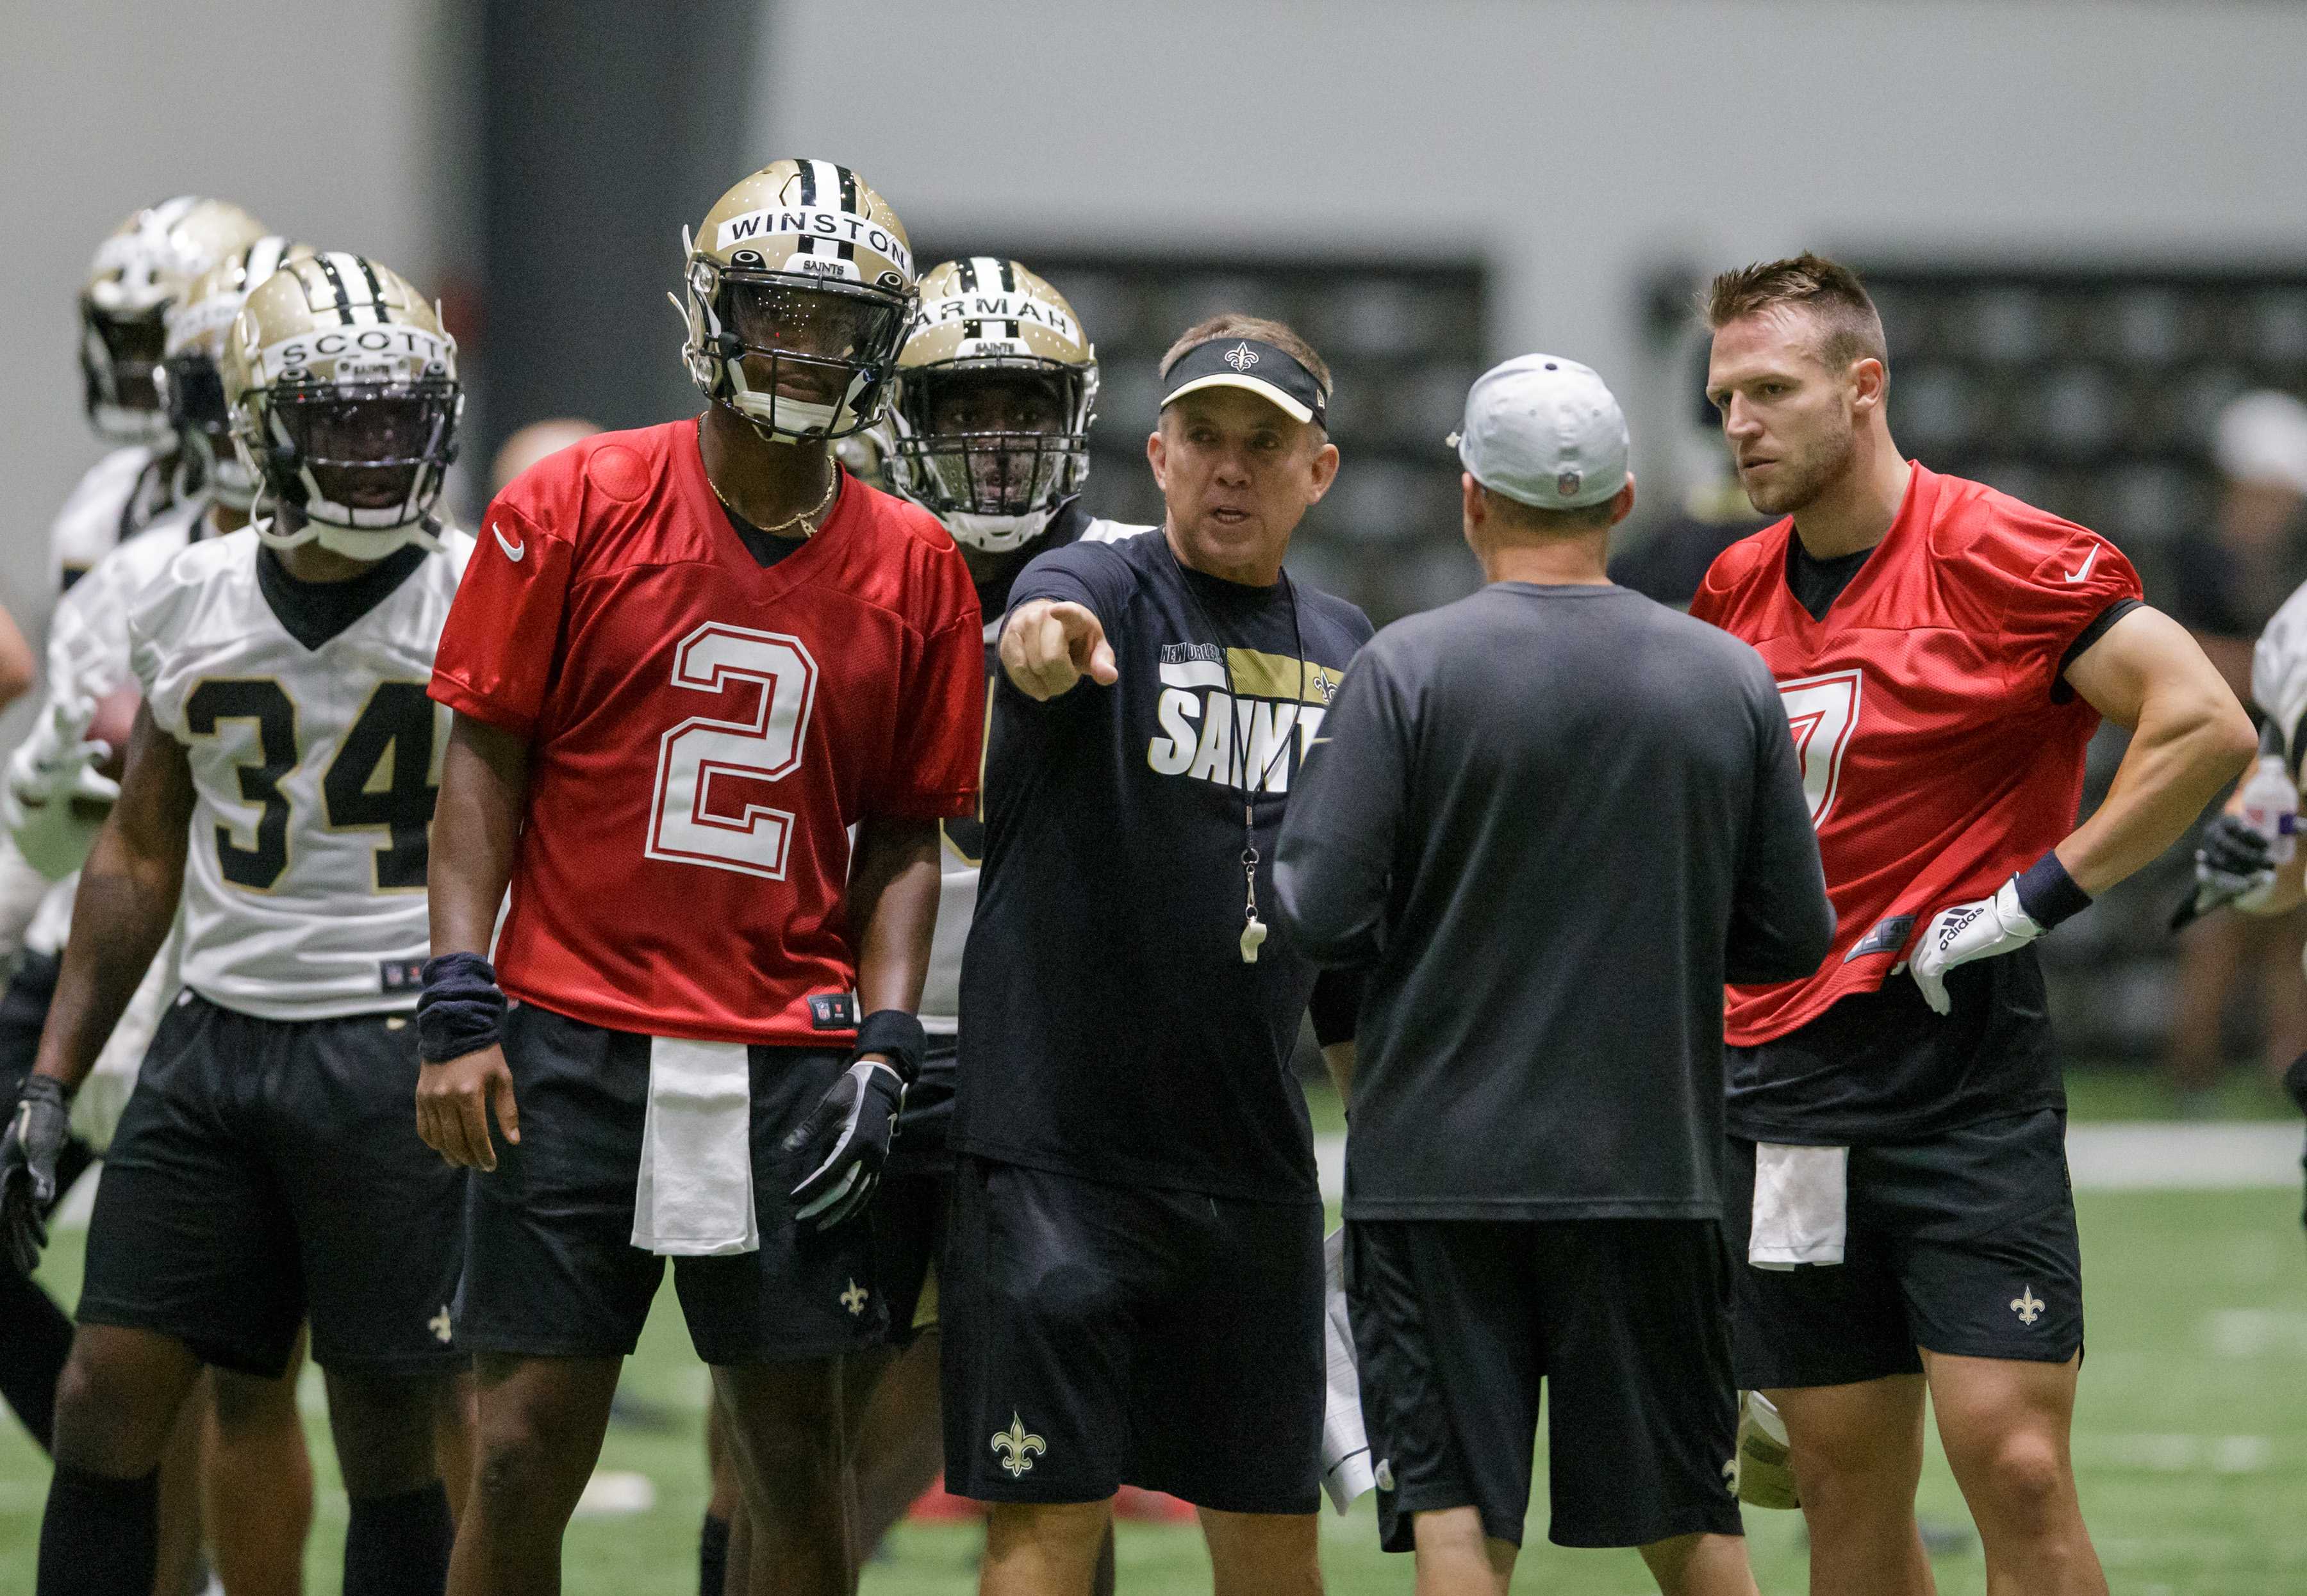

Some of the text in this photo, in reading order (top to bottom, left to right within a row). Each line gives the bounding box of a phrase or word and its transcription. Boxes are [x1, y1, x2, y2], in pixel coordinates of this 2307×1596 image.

[732, 211, 905, 270] WINSTON
[804, 260, 844, 276] SAINTS
[913, 299, 1067, 334] ARMAH
[283, 331, 438, 365] SCOTT
[1160, 642, 1187, 663] NEW
[645, 620, 819, 882] 2
[1146, 687, 1332, 793] SAINT
[184, 675, 444, 895] 34
[1939, 906, 1985, 952] adidas
